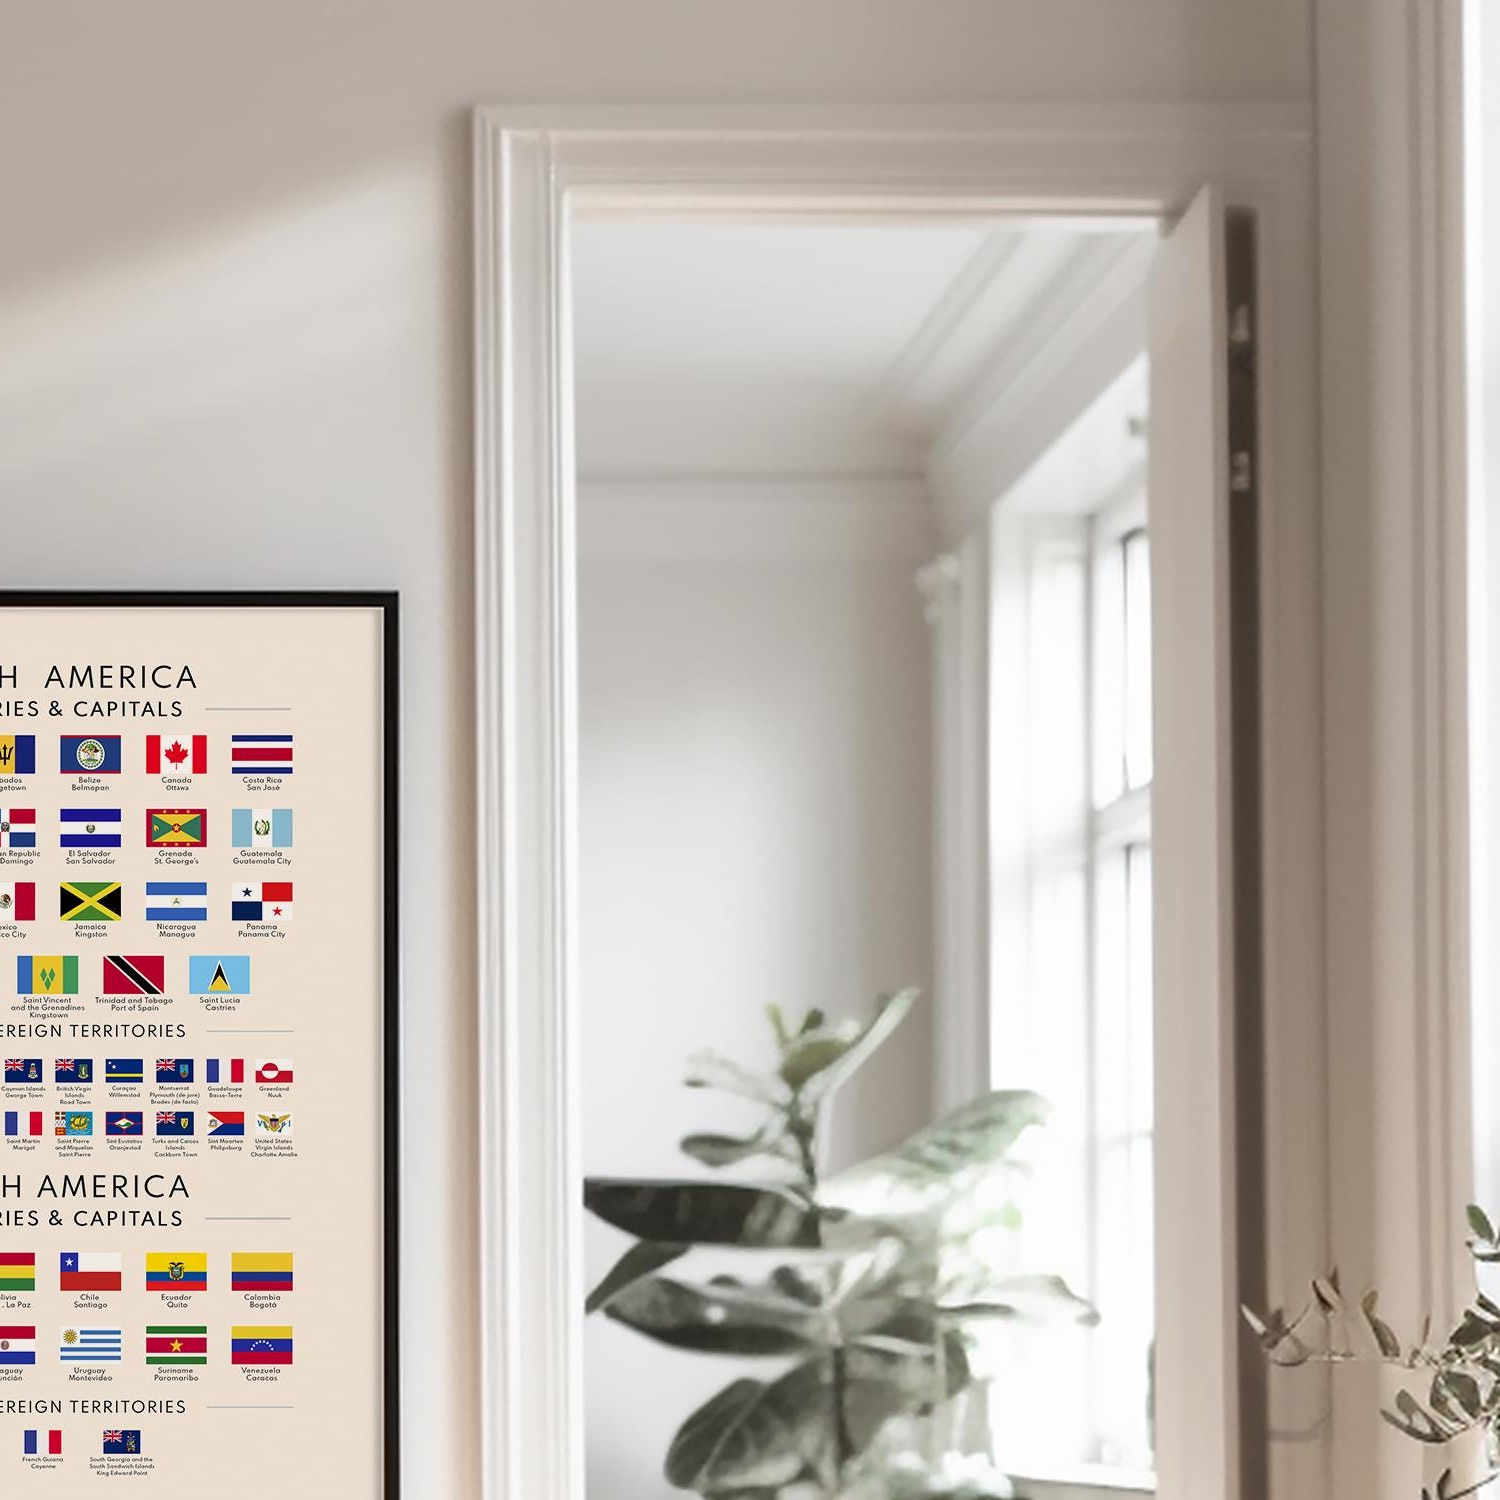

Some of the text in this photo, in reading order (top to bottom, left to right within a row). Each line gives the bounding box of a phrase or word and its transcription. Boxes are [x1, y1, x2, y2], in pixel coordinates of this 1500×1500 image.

[44, 665, 197, 688] AMERICA
[48, 701, 63, 717] &
[74, 701, 182, 717] CAPITALS
[71, 784, 110, 793] Belmopan
[8, 850, 40, 859] Republic
[0, 858, 34, 866] Domingo
[165, 858, 199, 866] George's
[276, 858, 292, 866] City
[74, 923, 107, 931] Jamaica
[156, 923, 196, 932] Nicaragua
[246, 923, 278, 931] Panama
[11, 931, 27, 940] City
[75, 931, 108, 940] Kingston
[159, 931, 195, 940] Managua
[270, 931, 286, 940] City
[144, 997, 173, 1005] Tobago
[137, 1005, 159, 1013] Spain
[29, 1012, 69, 1020] Kingstown
[69, 1024, 186, 1037] TERRITORIES
[37, 1175, 189, 1198] AMERICA
[48, 1210, 63, 1227] &
[74, 1210, 182, 1227] CAPITALS
[74, 1301, 108, 1310] Santiago
[249, 1301, 277, 1310] Bogotá
[74, 1367, 106, 1375] Uruguay
[69, 1400, 186, 1414] TERRITORIES
